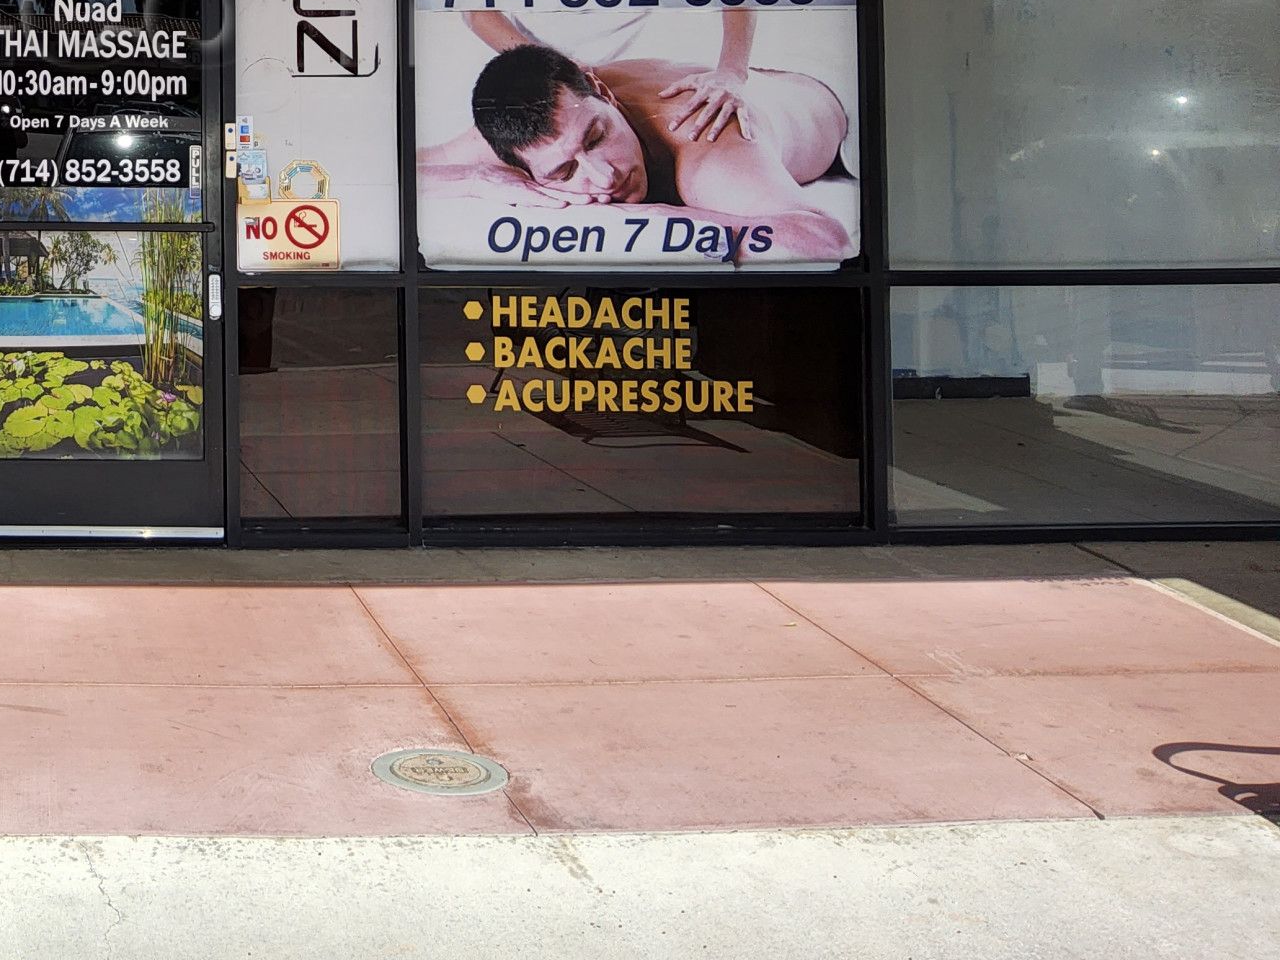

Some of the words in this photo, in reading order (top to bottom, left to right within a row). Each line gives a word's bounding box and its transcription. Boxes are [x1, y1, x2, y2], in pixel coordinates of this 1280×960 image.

[58, 29, 187, 59] MASSAGE
[10, 115, 49, 131] Open
[55, 115, 64, 129] 7
[70, 115, 106, 131] Days
[109, 115, 121, 128] A
[125, 115, 169, 128] Week
[65, 159, 181, 183] 852-3558
[191, 149, 202, 186] PULL
[245, 216, 278, 240] NO
[487, 216, 606, 262] Open
[624, 218, 649, 252] 7
[662, 217, 774, 262] Days
[262, 251, 311, 261] SMOKING
[492, 295, 690, 330] HEADACHE
[494, 336, 692, 370] BACKACHE
[493, 380, 754, 413] ACUPRESSURE
